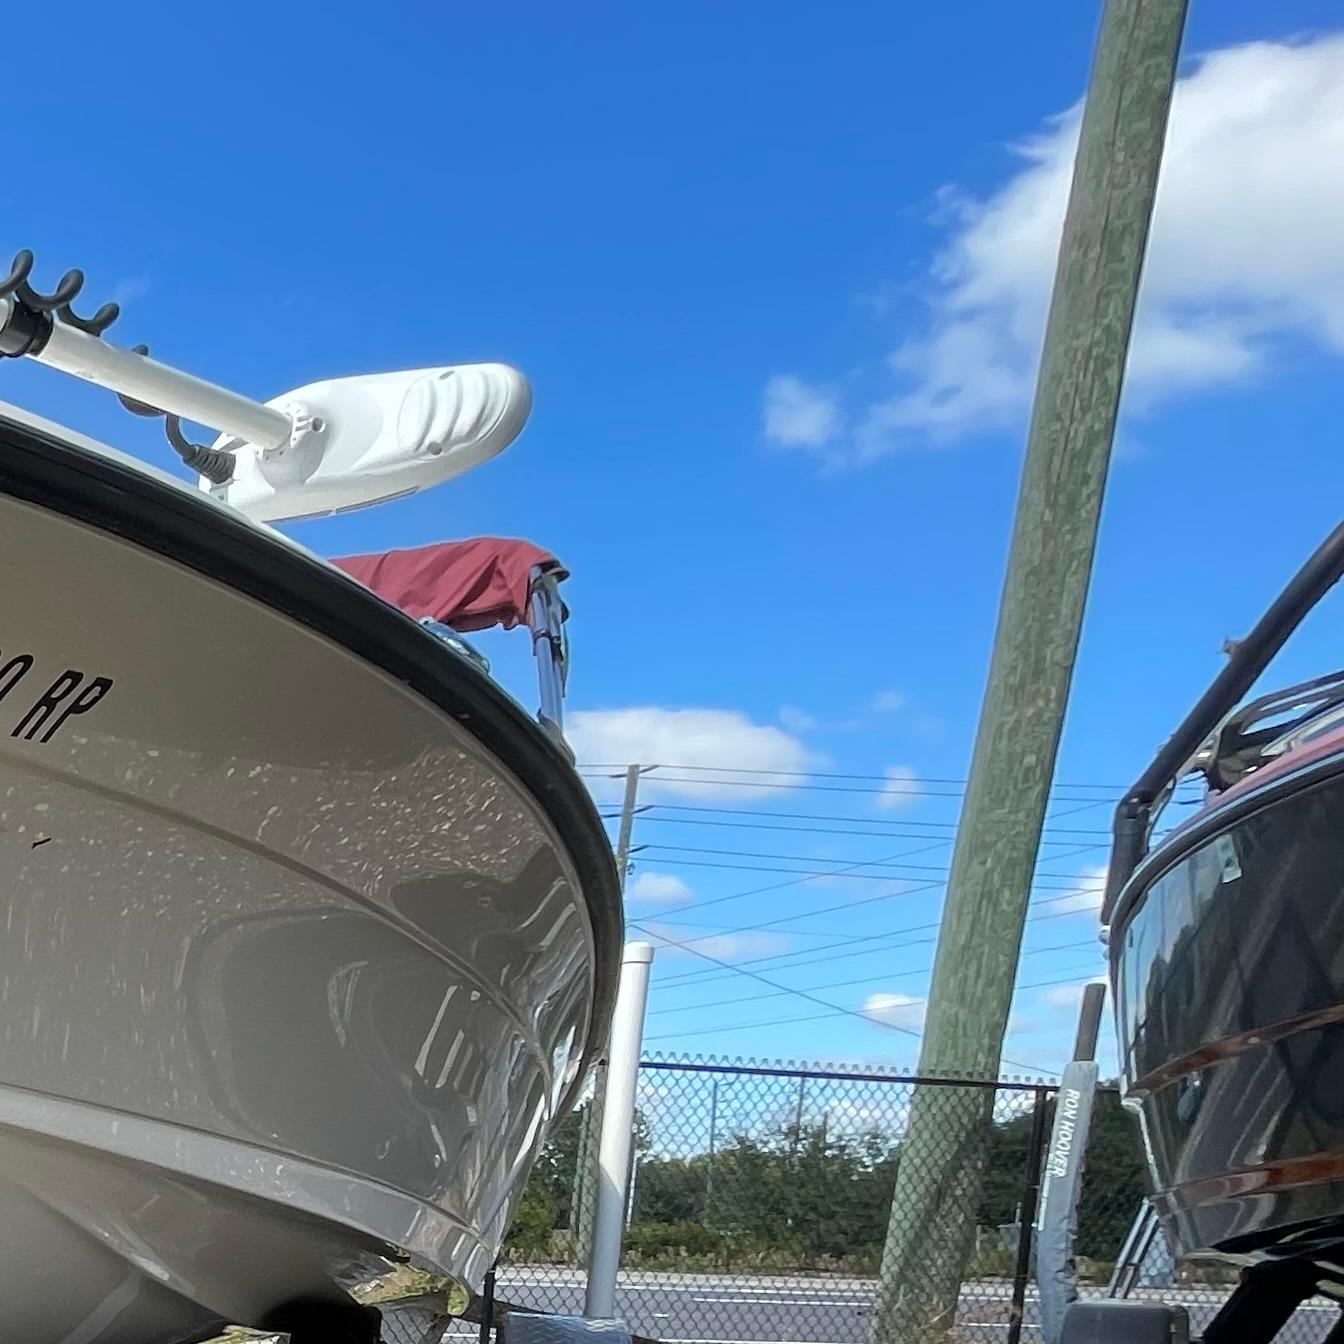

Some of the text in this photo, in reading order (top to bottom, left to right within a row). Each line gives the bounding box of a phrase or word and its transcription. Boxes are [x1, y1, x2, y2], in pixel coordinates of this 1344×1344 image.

[10, 669, 114, 744] RP
[1052, 1088, 1081, 1178] RON HOOVER
